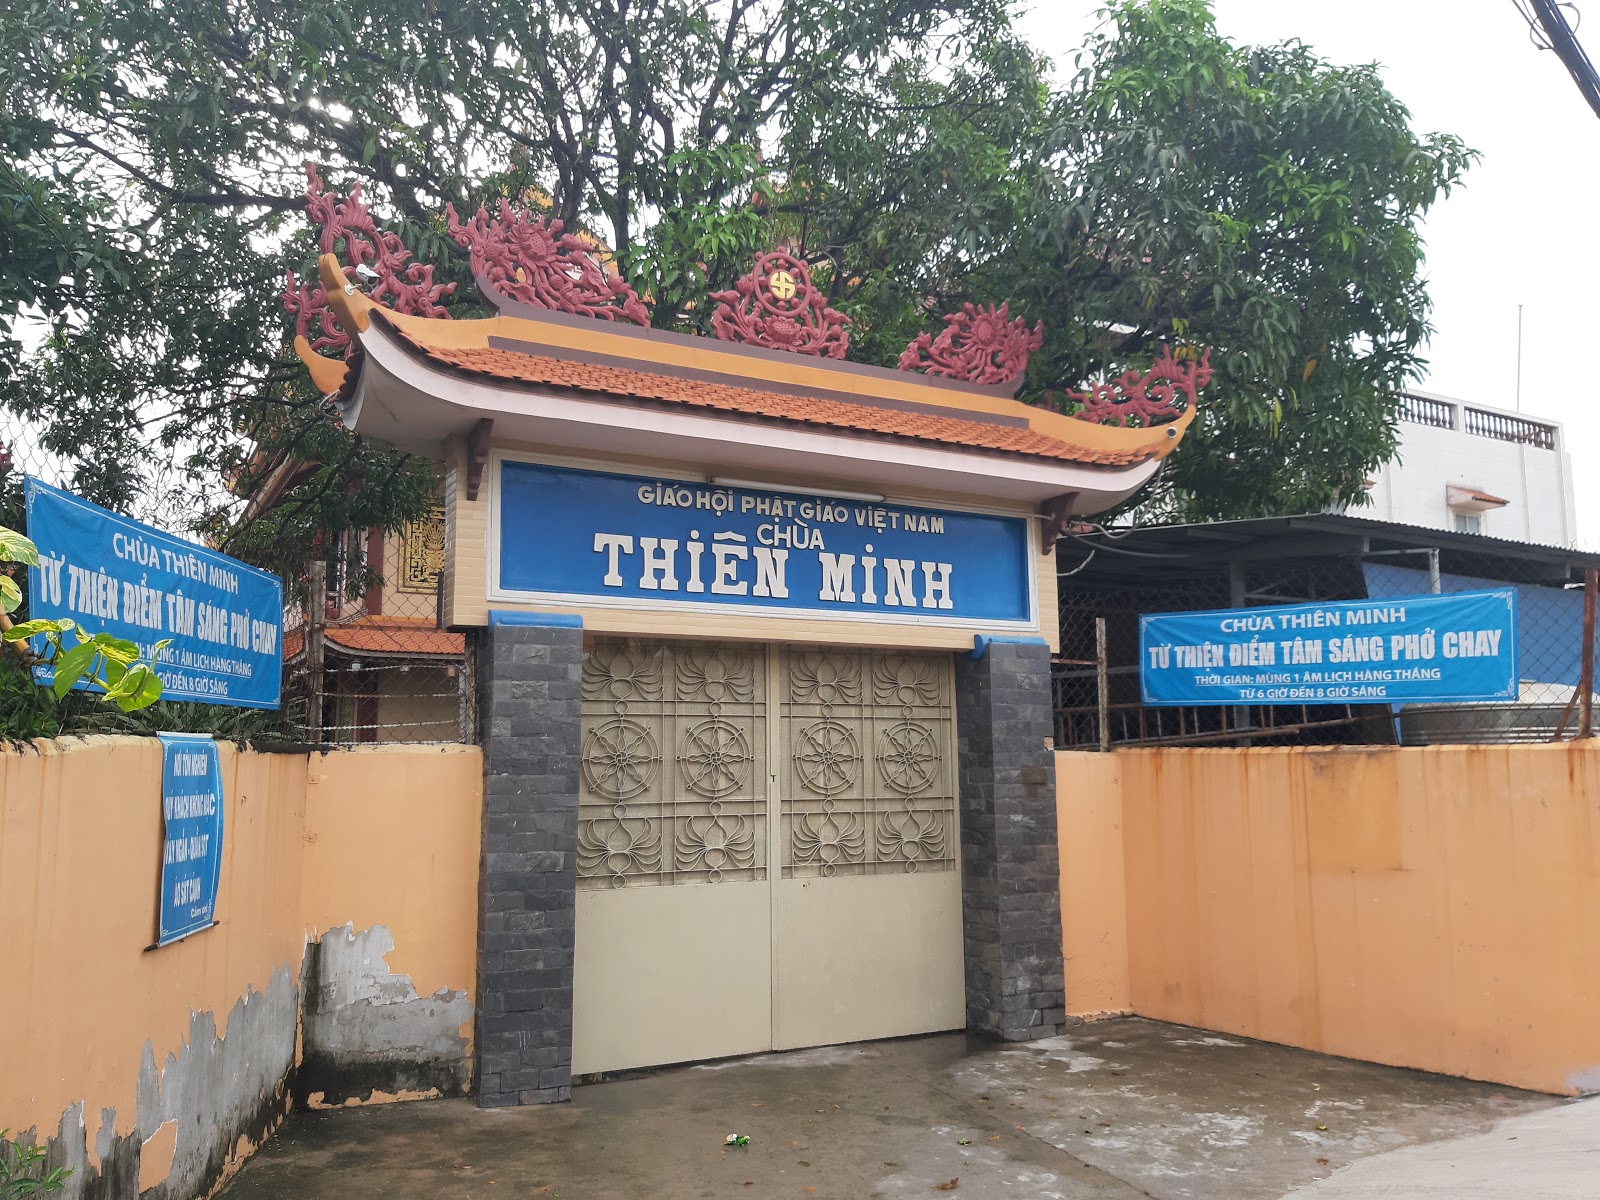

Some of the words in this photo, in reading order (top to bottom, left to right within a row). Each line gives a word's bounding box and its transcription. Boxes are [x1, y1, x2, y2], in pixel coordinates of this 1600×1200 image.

[637, 482, 692, 508] GIÁO
[696, 489, 734, 517] HỘI
[741, 496, 796, 523] PHẬT
[800, 499, 849, 524] GIÁO
[855, 505, 900, 534] VIỆT
[904, 514, 945, 534] NAM
[756, 517, 825, 550] CHÙA
[112, 532, 160, 570] CHÙA
[161, 548, 207, 584] THIÊN
[209, 564, 239, 595] MINH
[594, 529, 789, 599] THIÊN
[818, 543, 954, 609] MINH
[37, 550, 65, 607] TỪ
[68, 566, 118, 627] THIỆN
[122, 572, 163, 631] ĐIỂM
[166, 589, 195, 638] TÂM
[197, 599, 228, 645] SÁNG
[230, 608, 250, 651] PHỞ
[252, 618, 277, 656] CHAY
[1220, 614, 1275, 633] CHÙA
[1278, 609, 1340, 630] THIÊN
[1346, 607, 1406, 626] MINH
[176, 649, 180, 664] 1
[181, 647, 193, 667] ÂM
[193, 652, 210, 672] LỊCH
[210, 654, 231, 673] HÀNG
[232, 659, 252, 676] THÁNG
[1148, 643, 1172, 669] TỪ
[1174, 641, 1224, 672] THIỆN
[1228, 634, 1275, 667] ĐIỂM
[1281, 636, 1322, 665] TÂM
[1328, 634, 1384, 664] SÁNG
[1391, 627, 1436, 661] PHỞ
[1442, 629, 1502, 659] CHAY
[172, 670, 188, 691] ĐẾN
[189, 676, 195, 691] 8
[195, 675, 209, 693] GIỜ
[209, 677, 228, 695] SÁNG
[1195, 674, 1220, 685] THỜI
[1223, 674, 1254, 685] GIAN:
[1255, 672, 1291, 684] MÙNG
[1294, 673, 1299, 683] 1
[1303, 670, 1322, 683] ÂM
[1324, 671, 1352, 684] LỊCH
[1354, 669, 1392, 681] HÀNG
[1393, 666, 1441, 680] THÁNG
[1239, 687, 1256, 699] TỪ
[1257, 689, 1265, 698] 6
[1266, 687, 1288, 698] GIỜ
[1289, 685, 1315, 698] ĐẾN
[1316, 688, 1325, 697] 8
[1326, 685, 1350, 697] GIỜ
[1351, 684, 1387, 697] SÁNG
